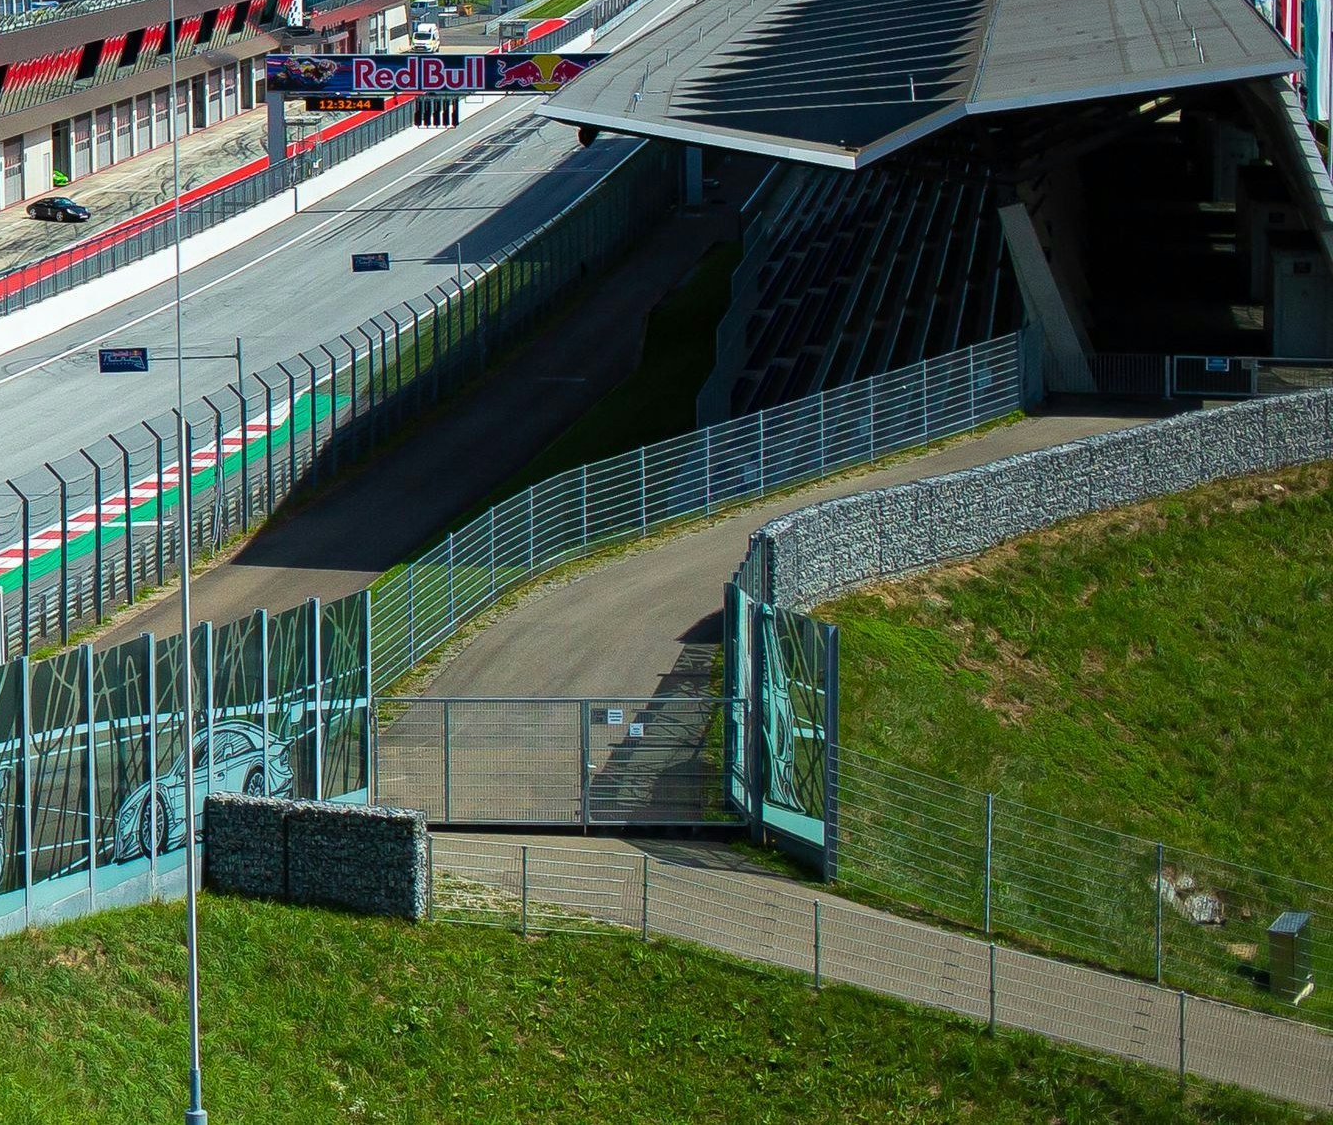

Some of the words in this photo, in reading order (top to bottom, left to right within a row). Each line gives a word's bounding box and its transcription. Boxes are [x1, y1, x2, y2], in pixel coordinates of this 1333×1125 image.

[353, 57, 418, 90] Red
[421, 56, 485, 90] Bull
[319, 99, 372, 109] 12:32:44
